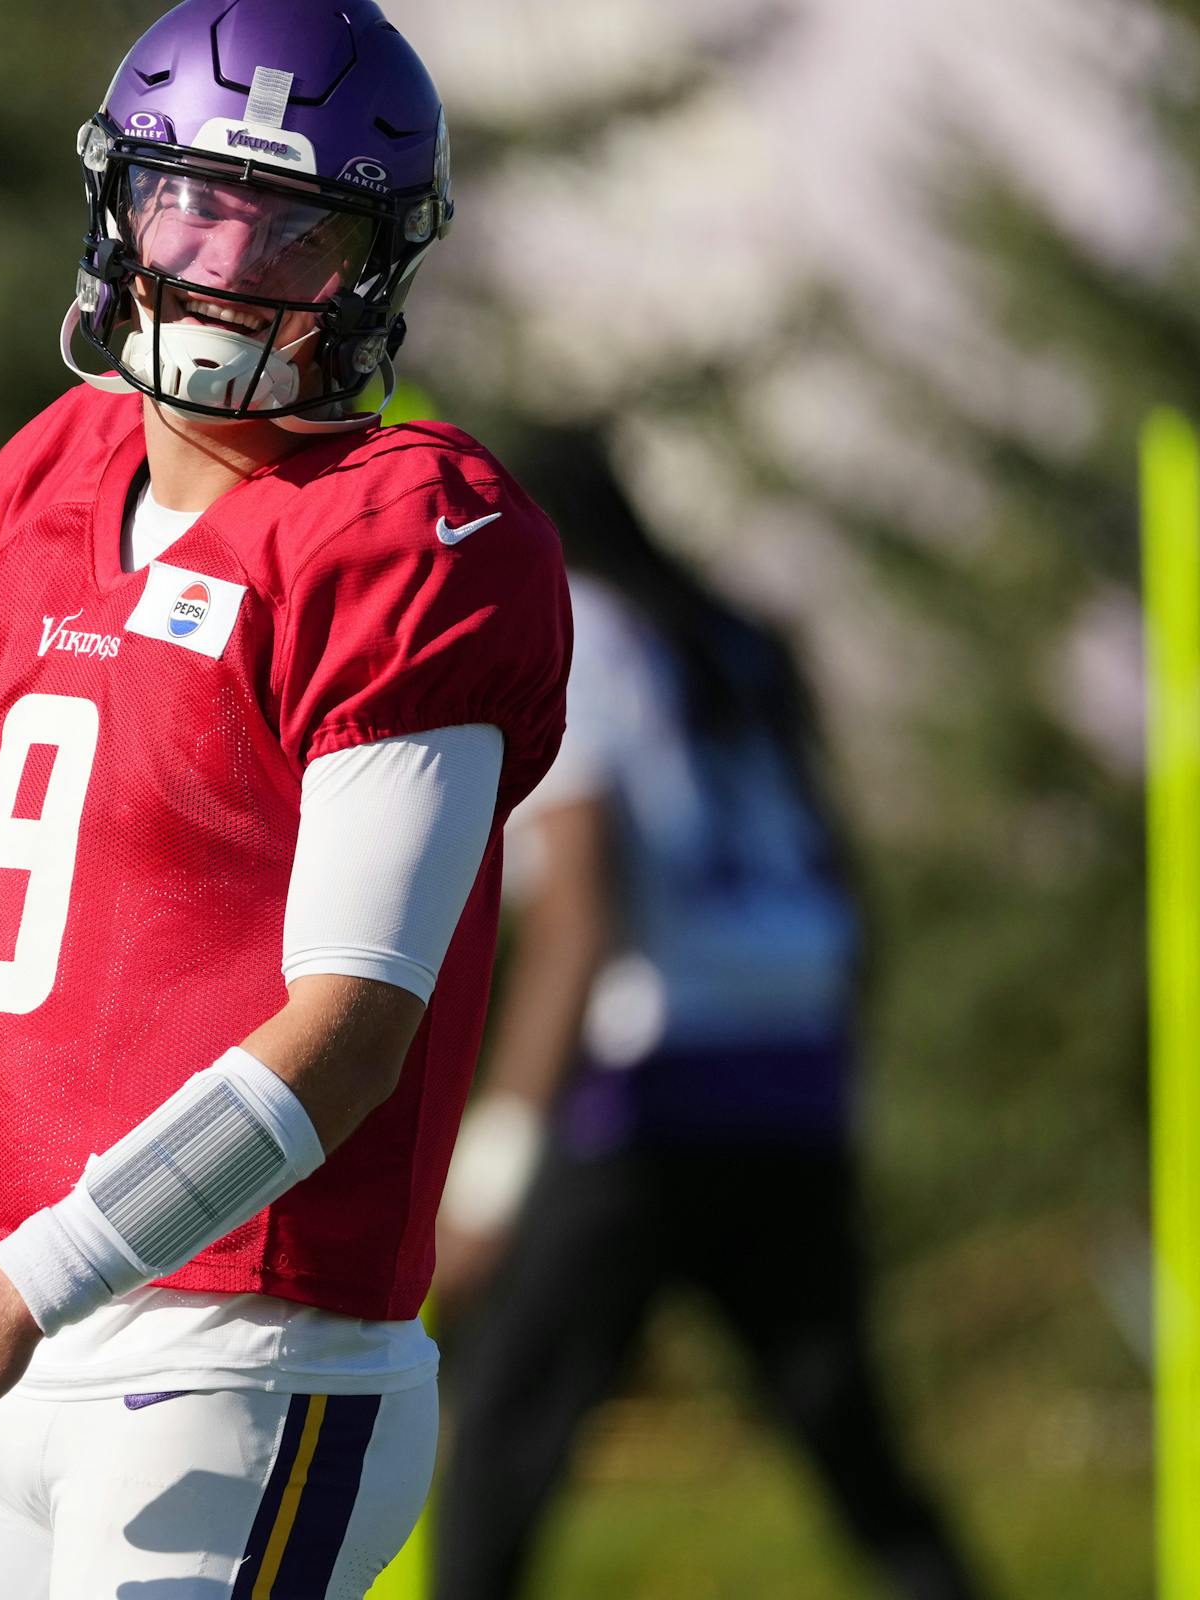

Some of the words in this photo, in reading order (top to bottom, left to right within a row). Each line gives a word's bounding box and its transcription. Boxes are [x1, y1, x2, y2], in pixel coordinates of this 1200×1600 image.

[125, 129, 162, 138] OAKLEY
[344, 173, 389, 193] OAKLEY
[173, 601, 206, 620] PEPSI
